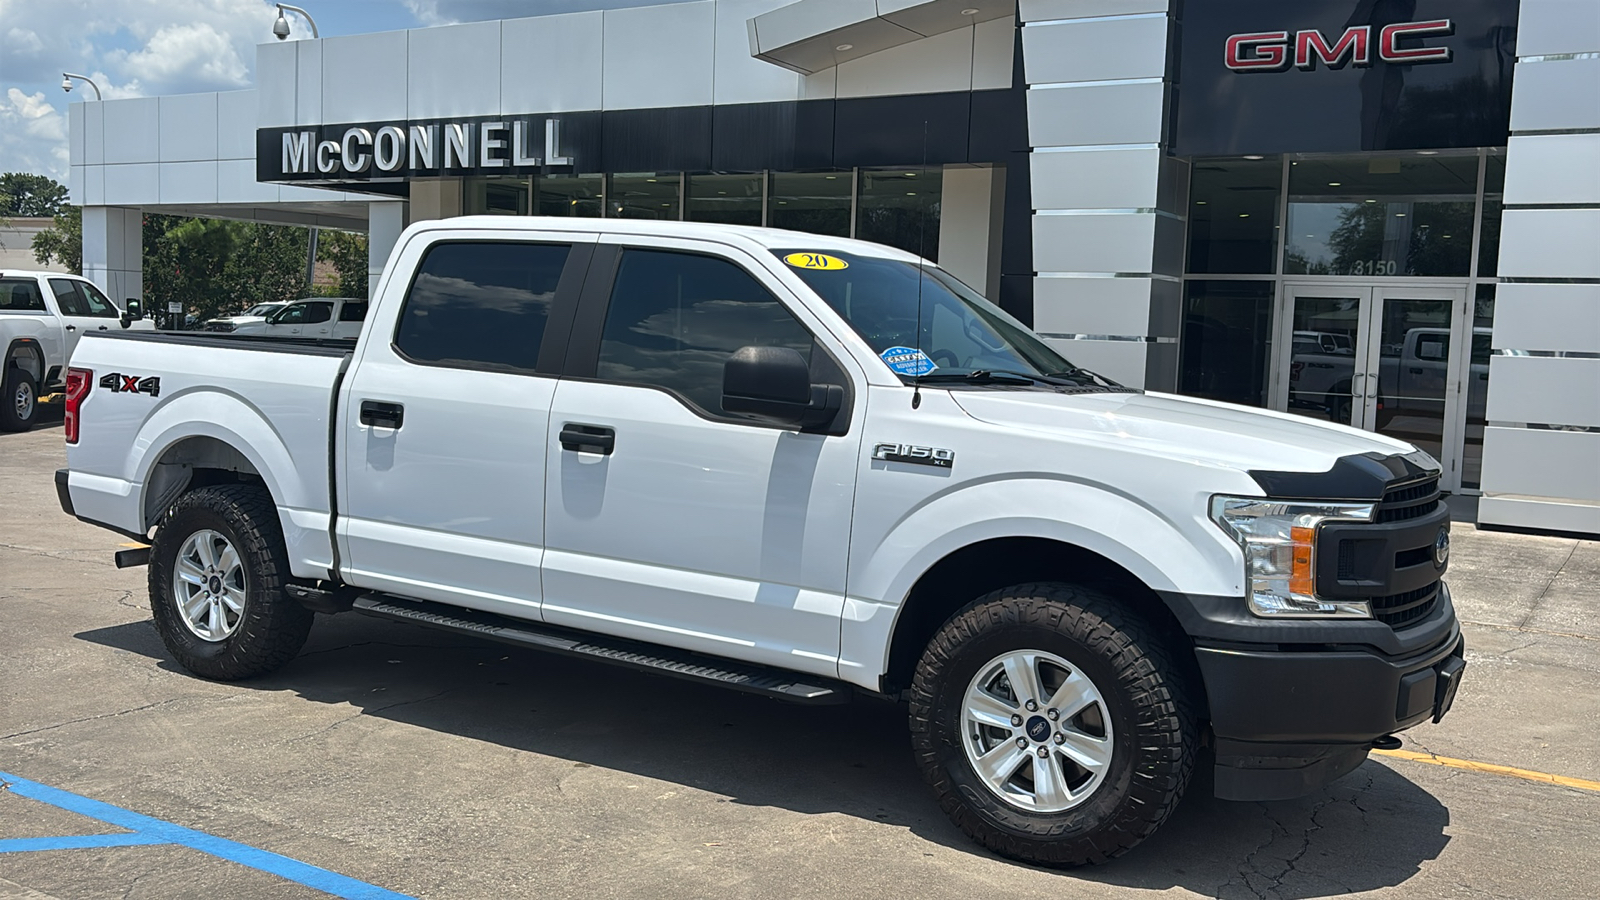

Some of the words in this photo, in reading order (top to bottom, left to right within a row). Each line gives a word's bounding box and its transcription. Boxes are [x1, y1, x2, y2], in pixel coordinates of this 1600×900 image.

[1224, 19, 1453, 71] GMC
[281, 119, 574, 174] McCONNELL
[801, 254, 828, 268] 20
[1354, 260, 1397, 276] 3150
